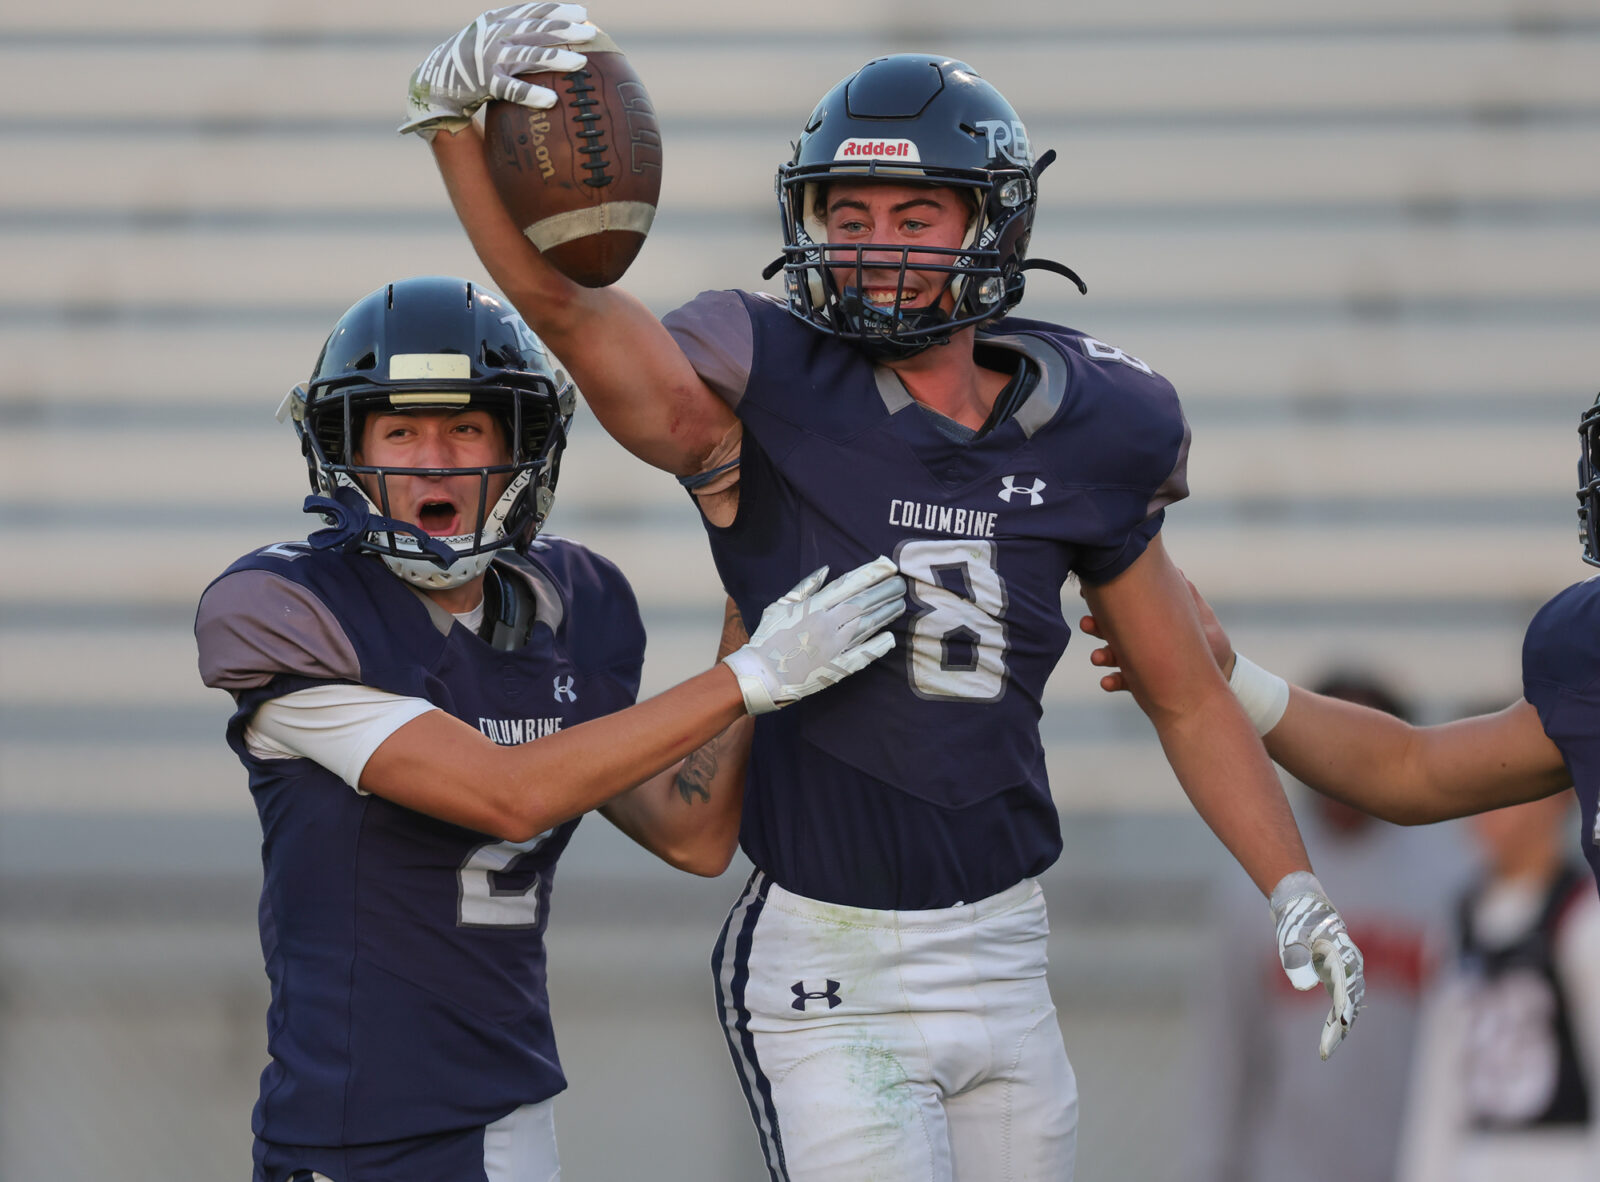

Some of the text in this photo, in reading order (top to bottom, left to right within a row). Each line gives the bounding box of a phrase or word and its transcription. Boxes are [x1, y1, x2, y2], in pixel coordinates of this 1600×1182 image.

[528, 107, 556, 181] ilson
[844, 142, 909, 157] Riddell
[976, 119, 1034, 167] RE
[889, 499, 998, 537] COLUMBINE
[893, 538, 1012, 703] 8
[479, 717, 563, 744] COLUMBINE
